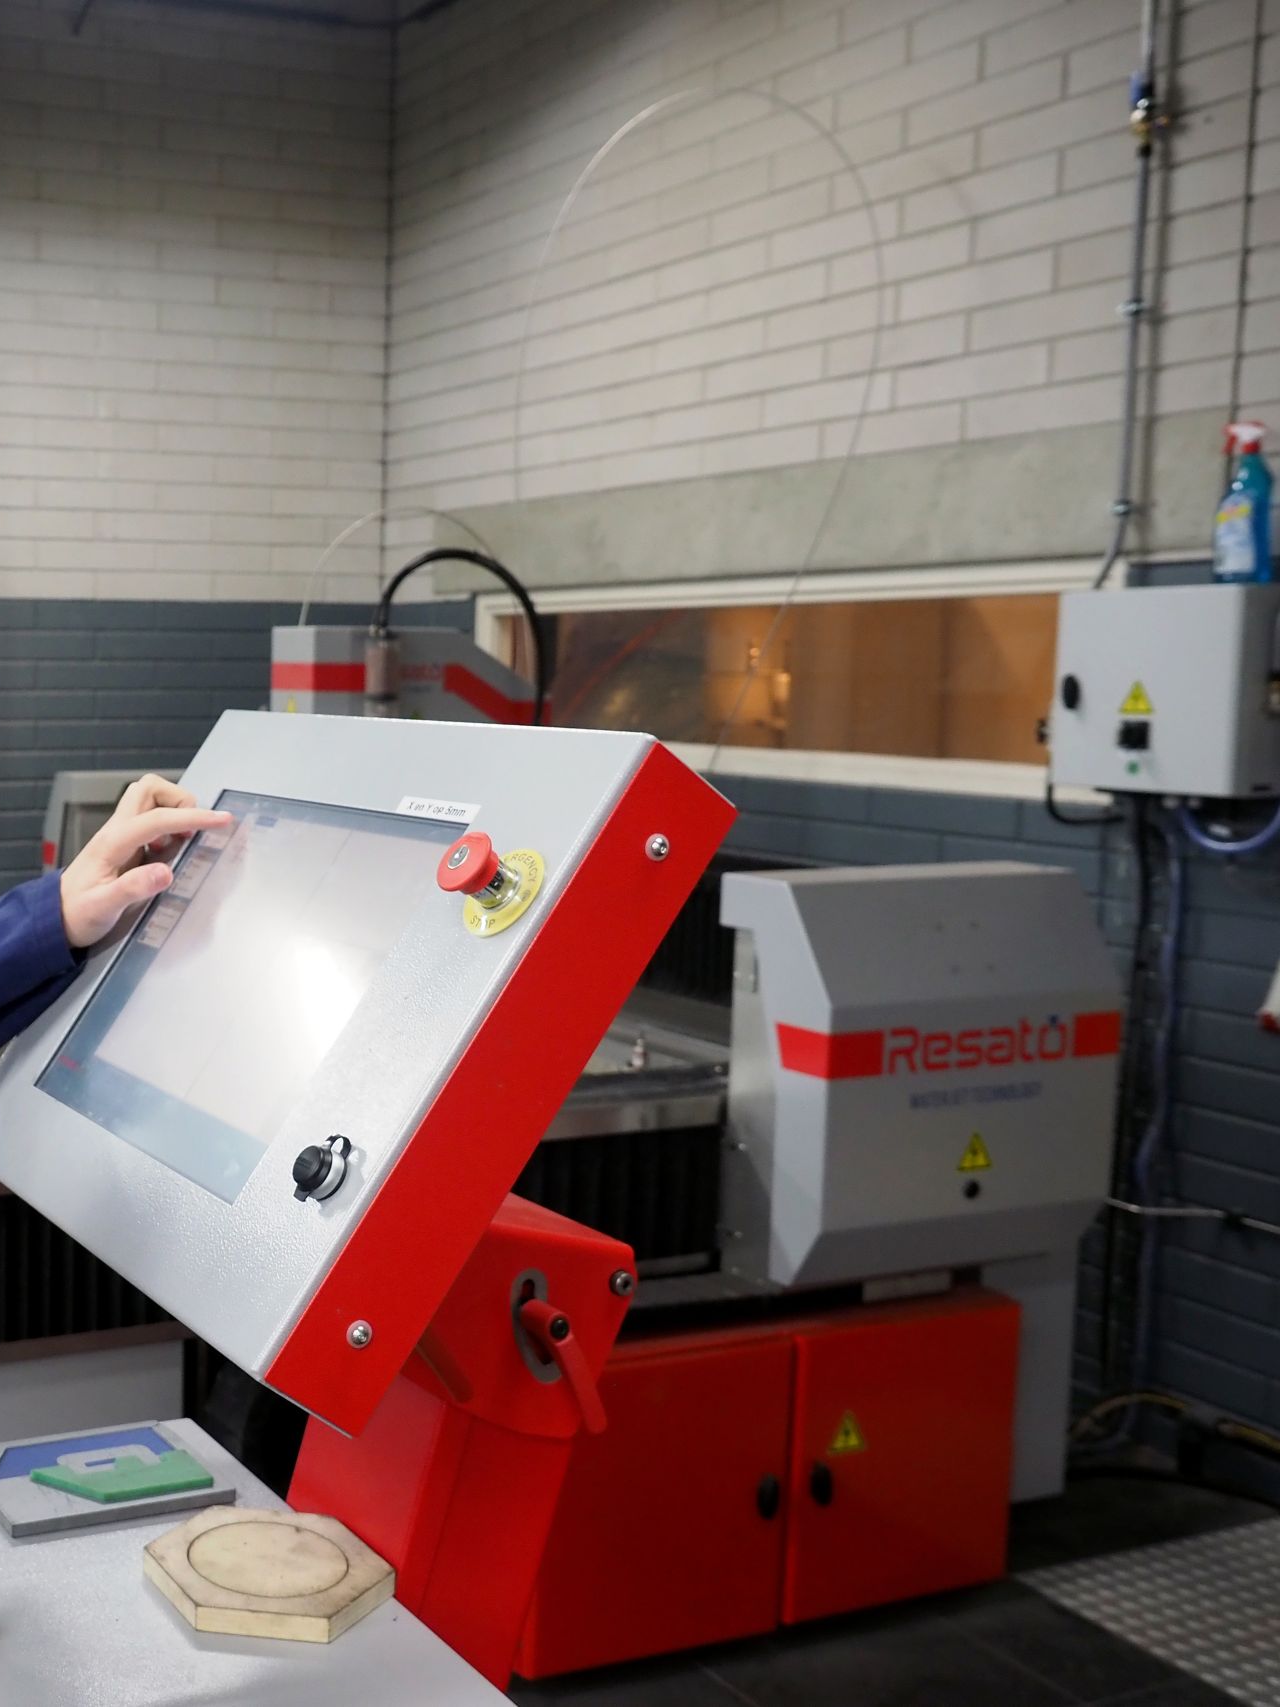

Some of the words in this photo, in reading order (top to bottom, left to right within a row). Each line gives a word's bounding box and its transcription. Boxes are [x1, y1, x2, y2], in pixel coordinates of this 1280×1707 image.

[407, 801, 415, 810] X
[426, 804, 433, 813] Y
[432, 806, 445, 815] op
[888, 1015, 1068, 1075] Resato
